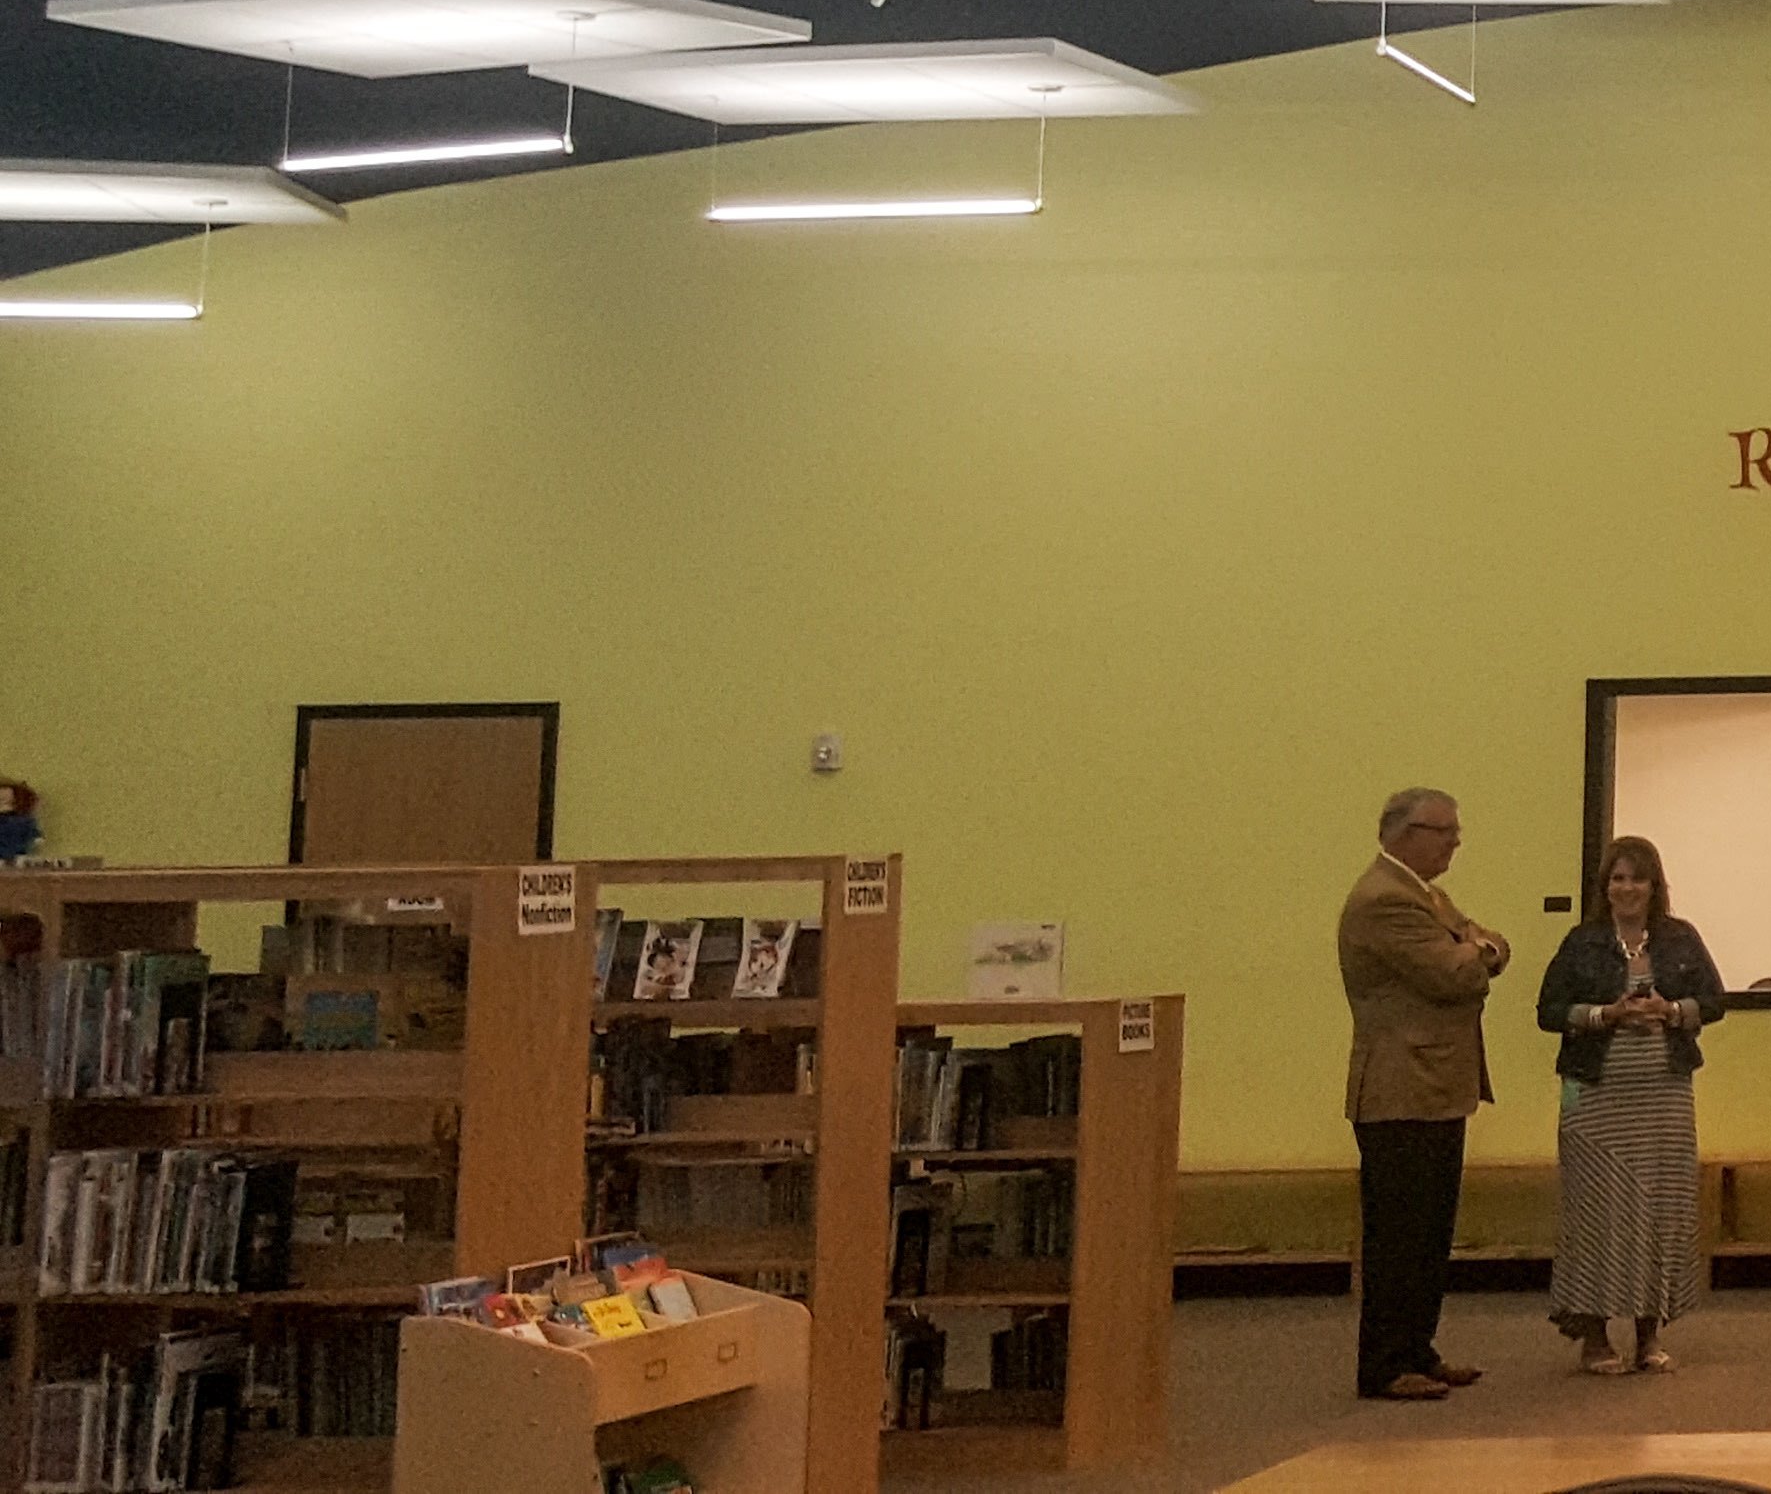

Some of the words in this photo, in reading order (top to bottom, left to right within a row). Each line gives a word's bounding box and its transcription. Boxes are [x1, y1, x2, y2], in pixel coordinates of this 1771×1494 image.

[522, 873, 573, 896] CHILDREN'S
[848, 886, 884, 908] FICTION
[522, 902, 573, 926] Nonfiction
[1121, 1022, 1151, 1041] BOOKS
